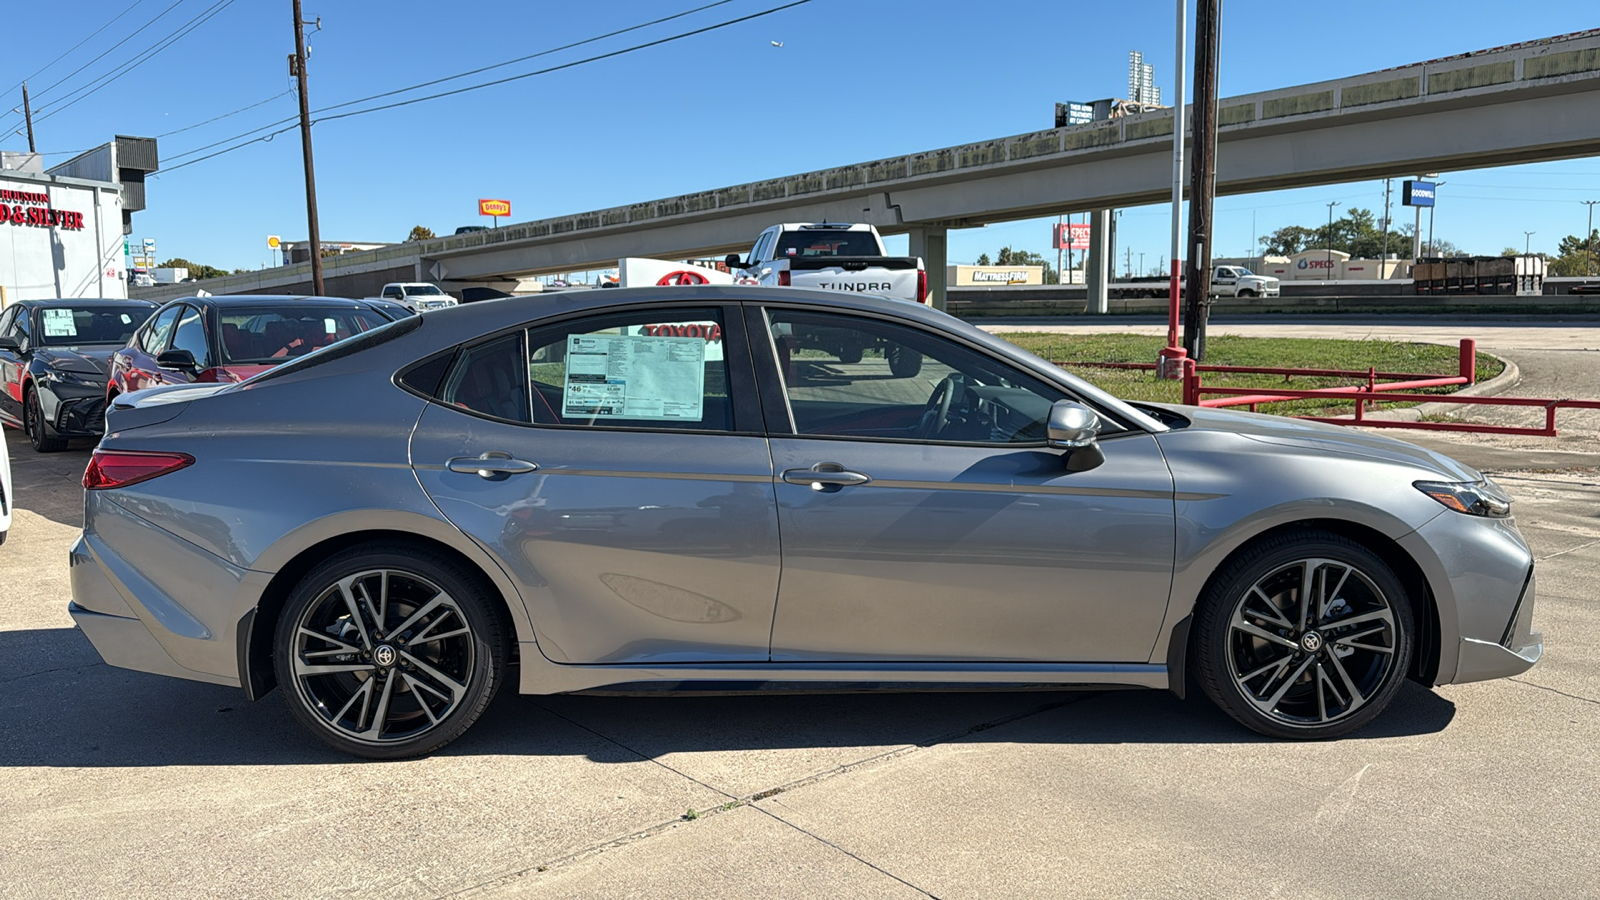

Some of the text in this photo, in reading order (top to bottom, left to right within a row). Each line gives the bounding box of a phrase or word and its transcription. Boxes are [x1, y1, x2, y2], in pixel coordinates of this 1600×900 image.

[1, 189, 49, 203] HOUSTON
[1411, 189, 1435, 199] GOODWILL
[485, 203, 507, 212] Denny's
[13, 205, 27, 224] &
[29, 206, 85, 229] SILVER
[819, 282, 892, 292] TUNDRA
[643, 323, 722, 341] TOYOTA
